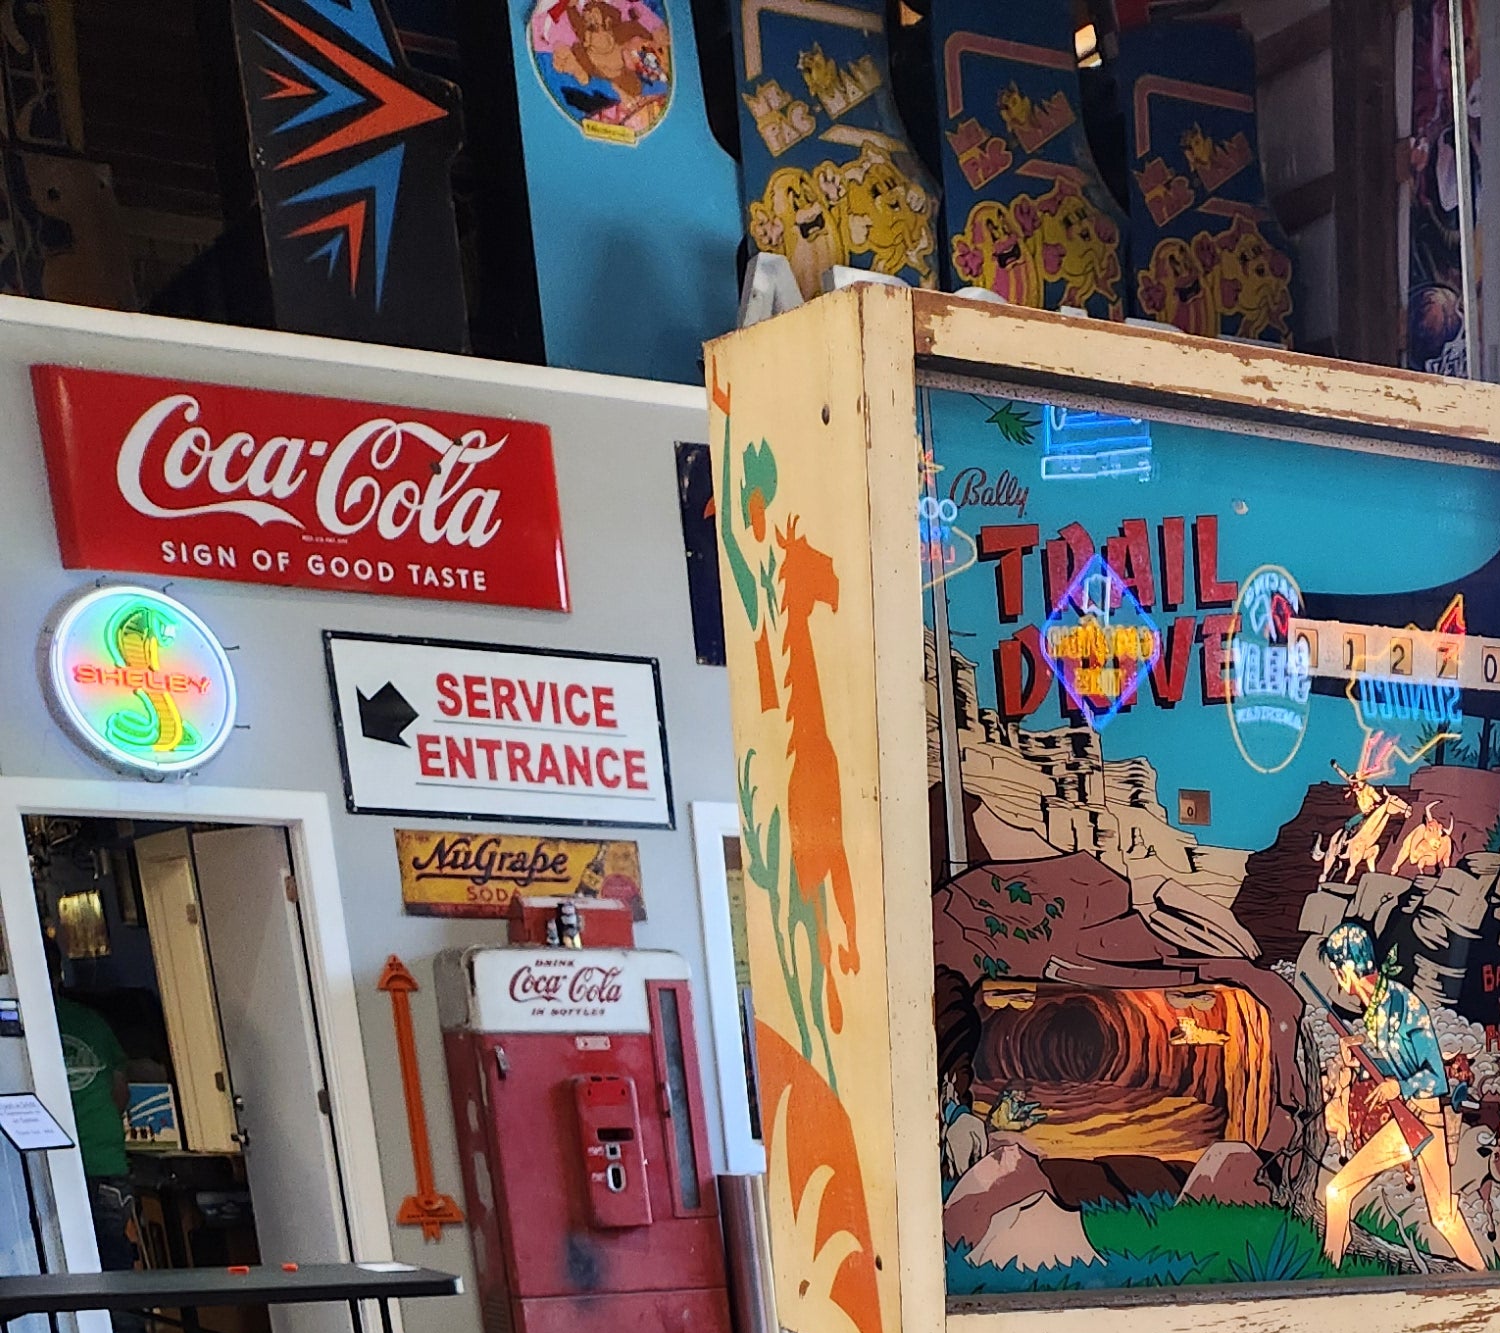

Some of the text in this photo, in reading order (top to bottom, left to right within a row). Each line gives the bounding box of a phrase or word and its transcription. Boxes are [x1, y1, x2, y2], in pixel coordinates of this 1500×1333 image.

[116, 395, 508, 548] Coca-Cola
[949, 466, 1030, 518] Bally
[161, 540, 487, 591] SIGN OF GOOD TASTE
[975, 514, 1238, 622] TRAIL
[72, 663, 211, 695] SHELBY
[998, 612, 1243, 718] DRIVE
[436, 672, 618, 729] SERVICE
[415, 733, 649, 791] ENTRANCE
[412, 837, 569, 886] NuGrape
[508, 965, 625, 1004] Coca-Cola
[535, 958, 576, 968] DRINK
